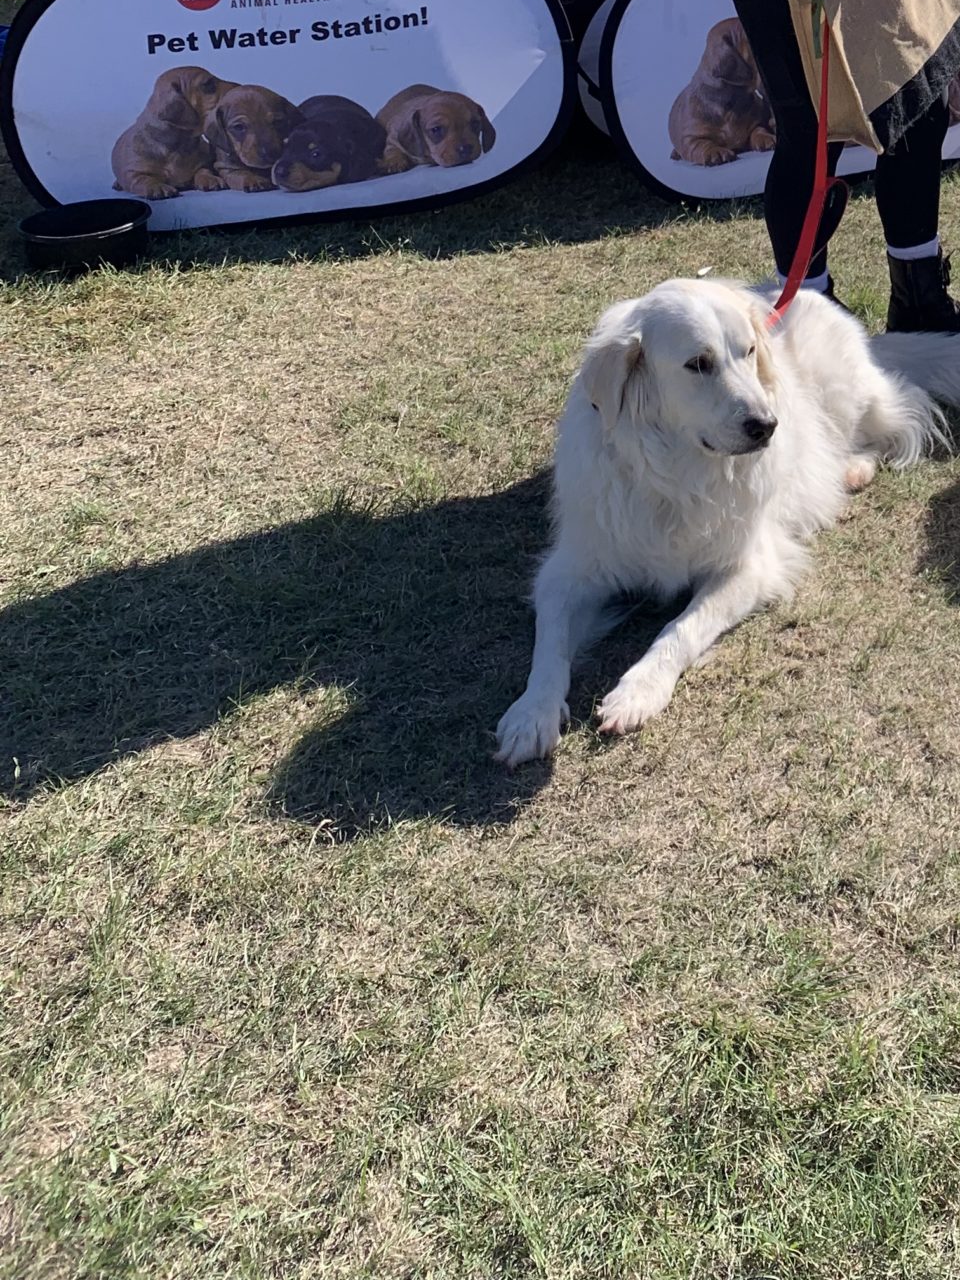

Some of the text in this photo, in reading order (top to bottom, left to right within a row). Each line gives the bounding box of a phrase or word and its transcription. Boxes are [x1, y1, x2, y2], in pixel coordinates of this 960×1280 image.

[147, 6, 429, 54] Pet Water Station!
